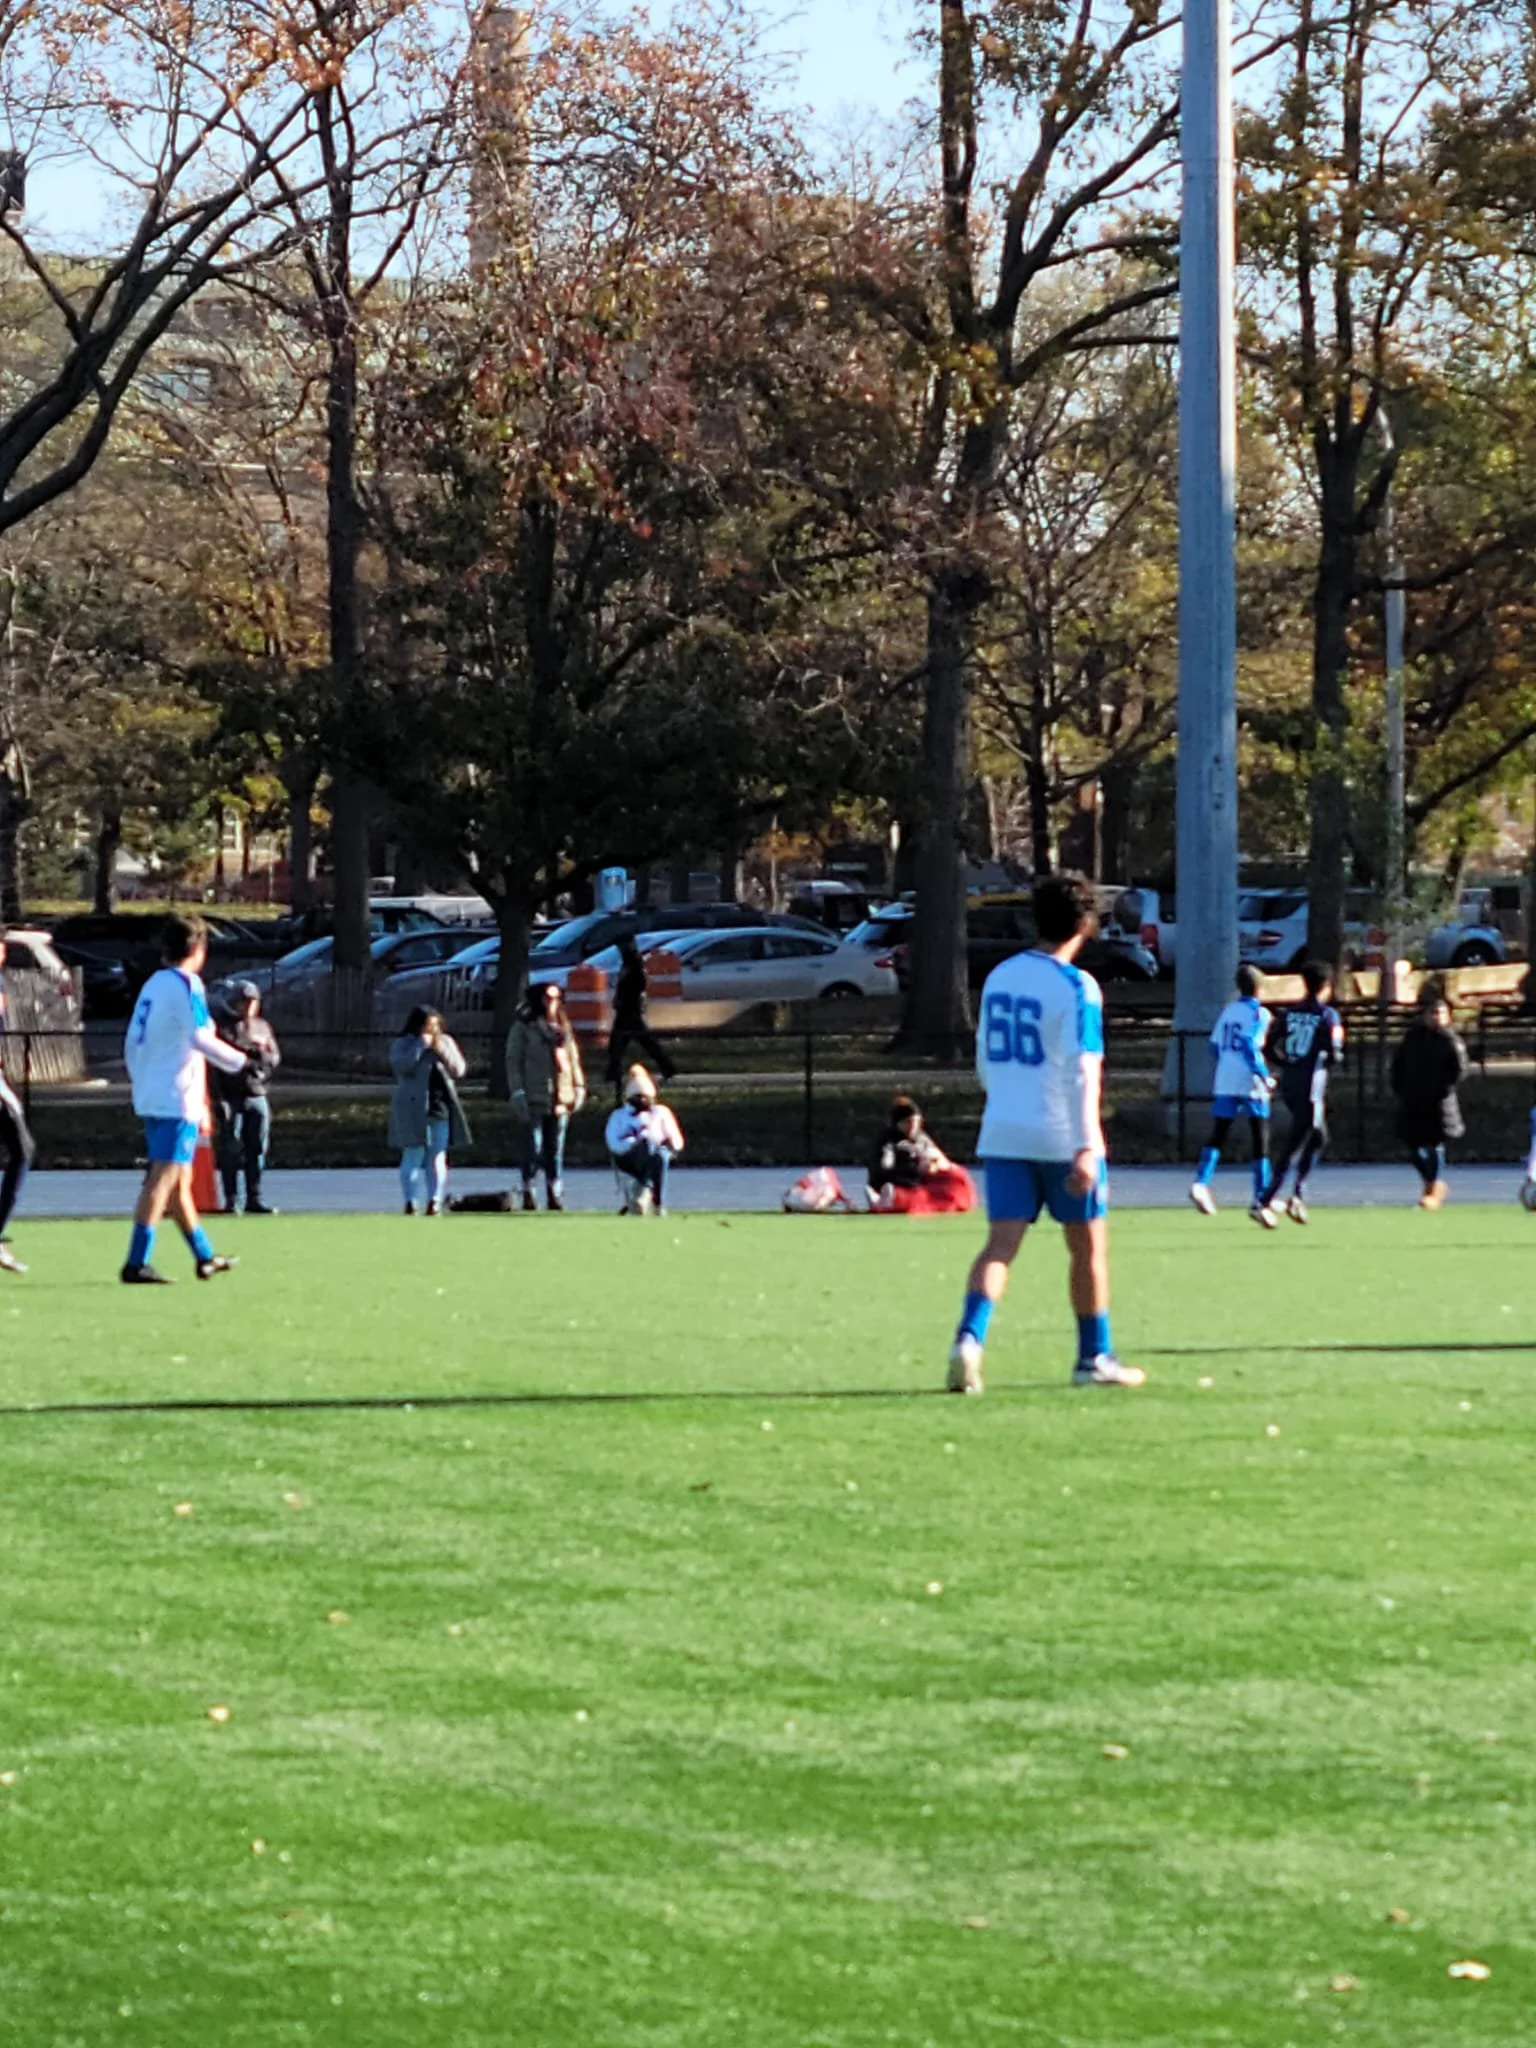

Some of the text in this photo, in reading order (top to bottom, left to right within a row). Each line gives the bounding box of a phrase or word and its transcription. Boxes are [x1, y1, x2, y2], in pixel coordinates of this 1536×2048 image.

[986, 992, 1046, 1066] 66
[1222, 1022, 1243, 1052] 16
[1285, 1021, 1316, 1056] 20
